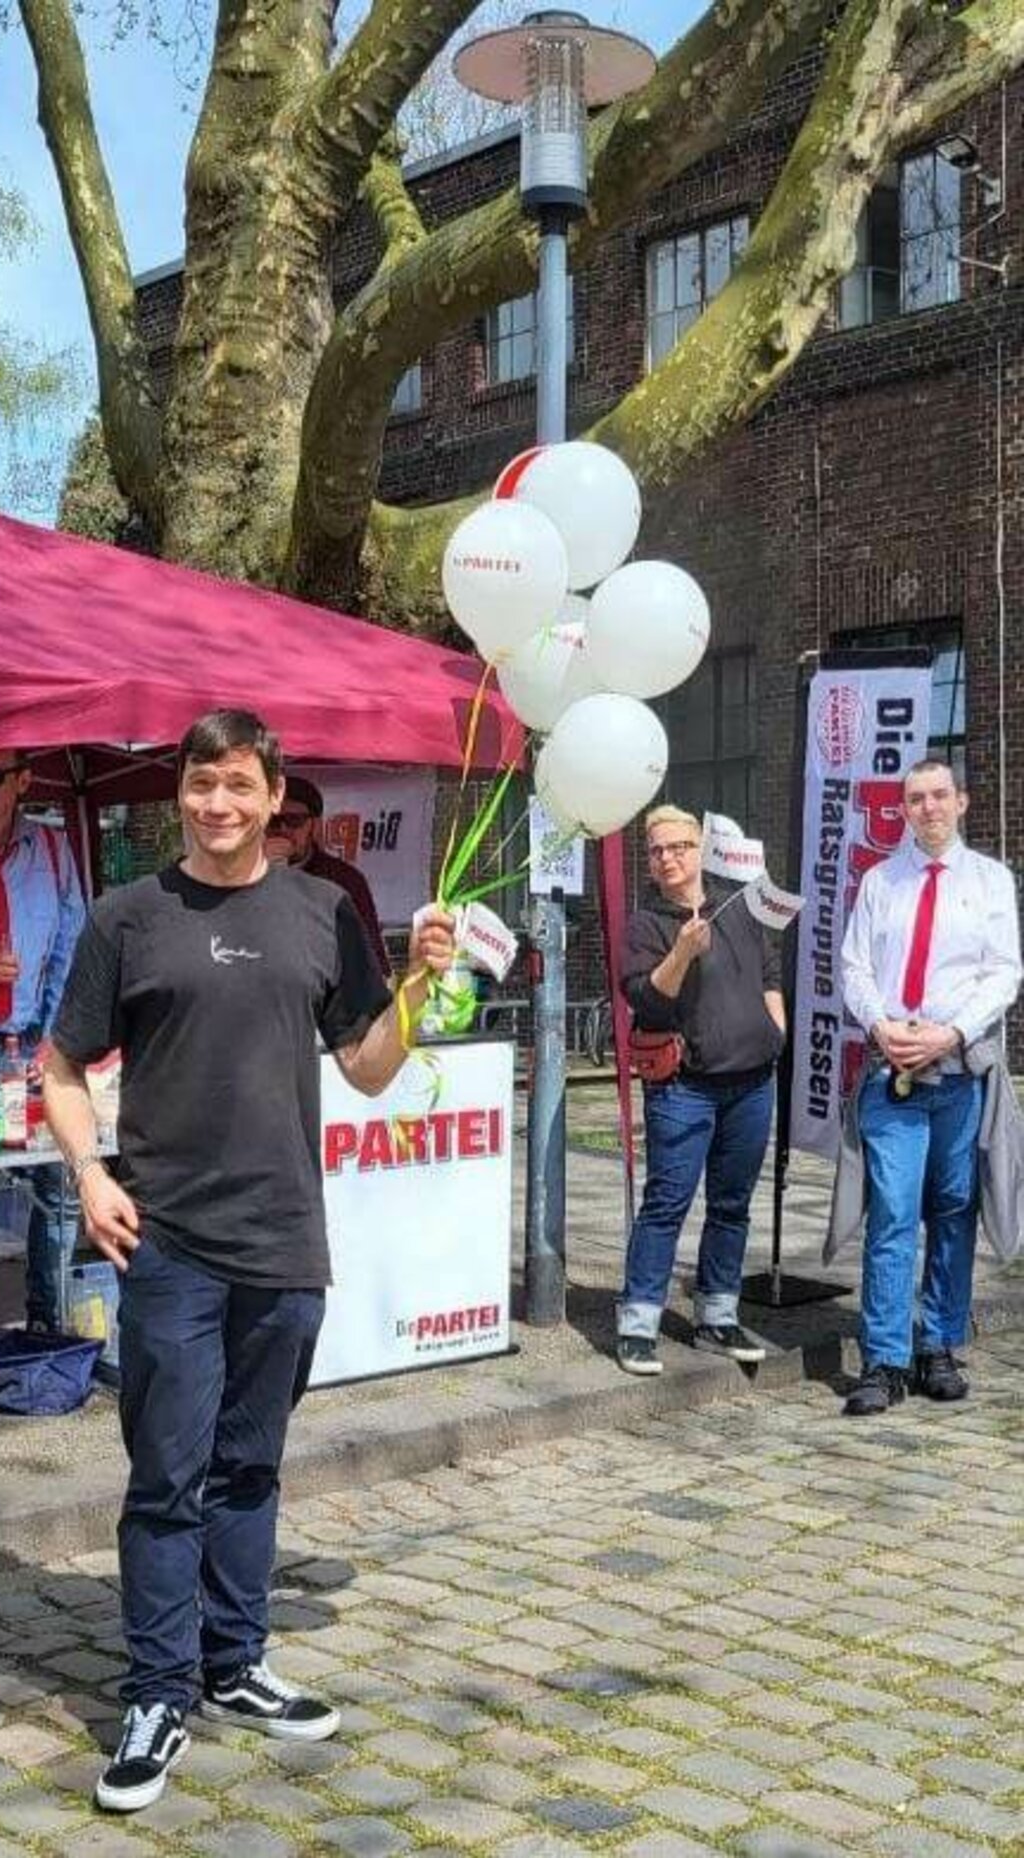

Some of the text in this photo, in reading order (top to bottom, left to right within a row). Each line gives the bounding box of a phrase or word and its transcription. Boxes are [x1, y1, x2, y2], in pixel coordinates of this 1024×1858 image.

[873, 698, 914, 776] Die
[807, 778, 850, 1120] Ratsgruppe Essen
[324, 1108, 504, 1176] PARTEI
[417, 1304, 500, 1340] PARTEI
